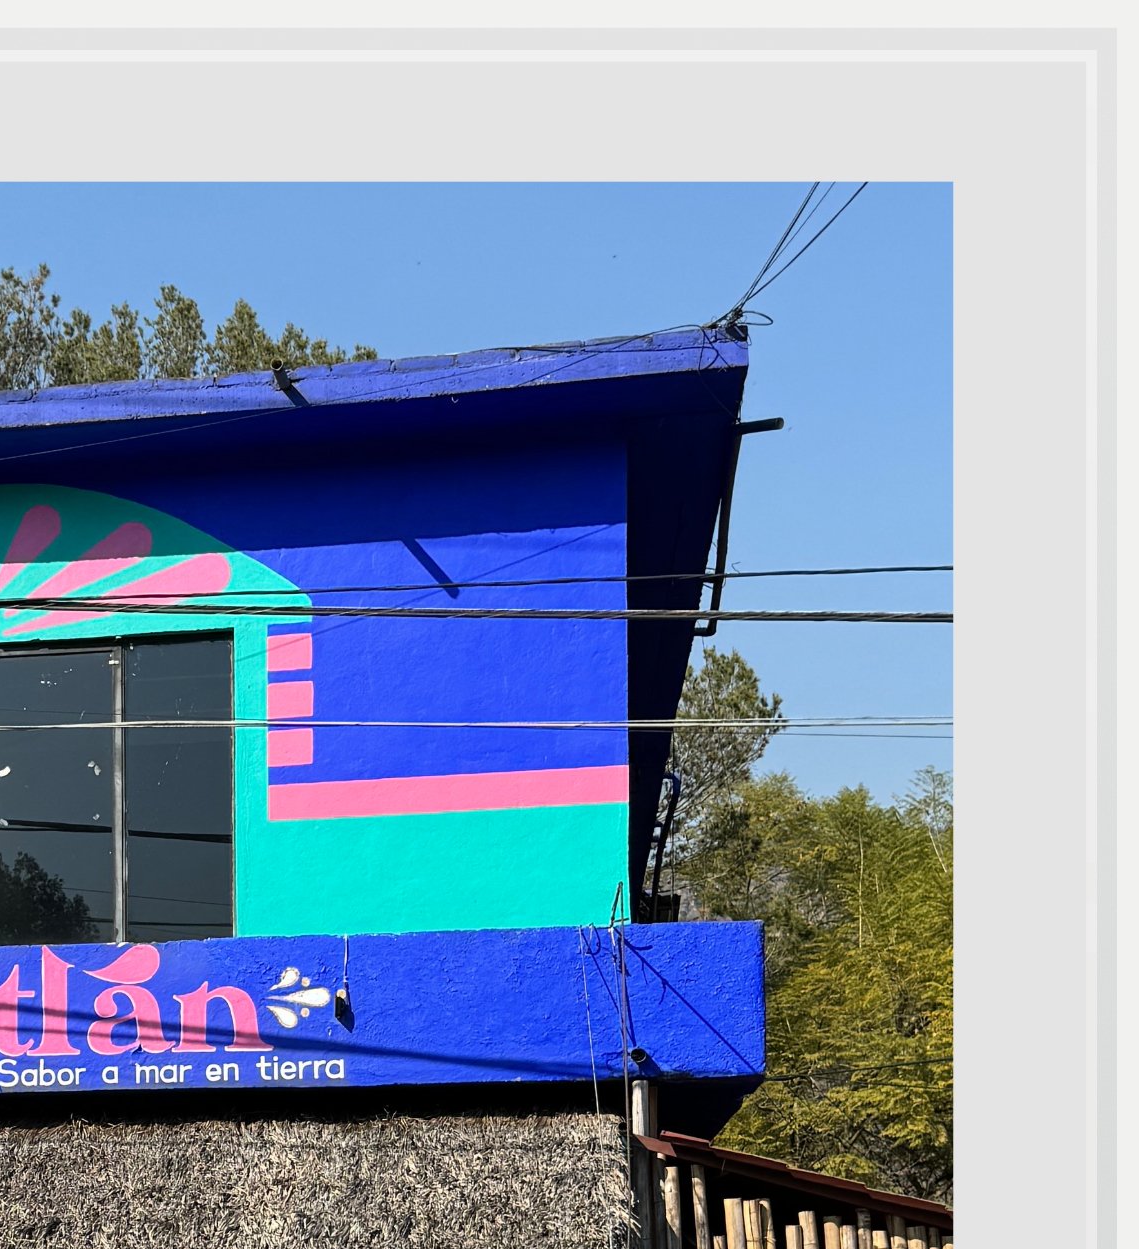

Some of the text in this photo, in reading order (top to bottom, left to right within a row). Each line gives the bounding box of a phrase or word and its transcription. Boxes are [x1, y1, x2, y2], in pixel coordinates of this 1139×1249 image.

[101, 1065, 120, 1085] a
[135, 1062, 193, 1084] mar
[205, 1060, 240, 1083] en
[257, 1055, 346, 1081] tierra
